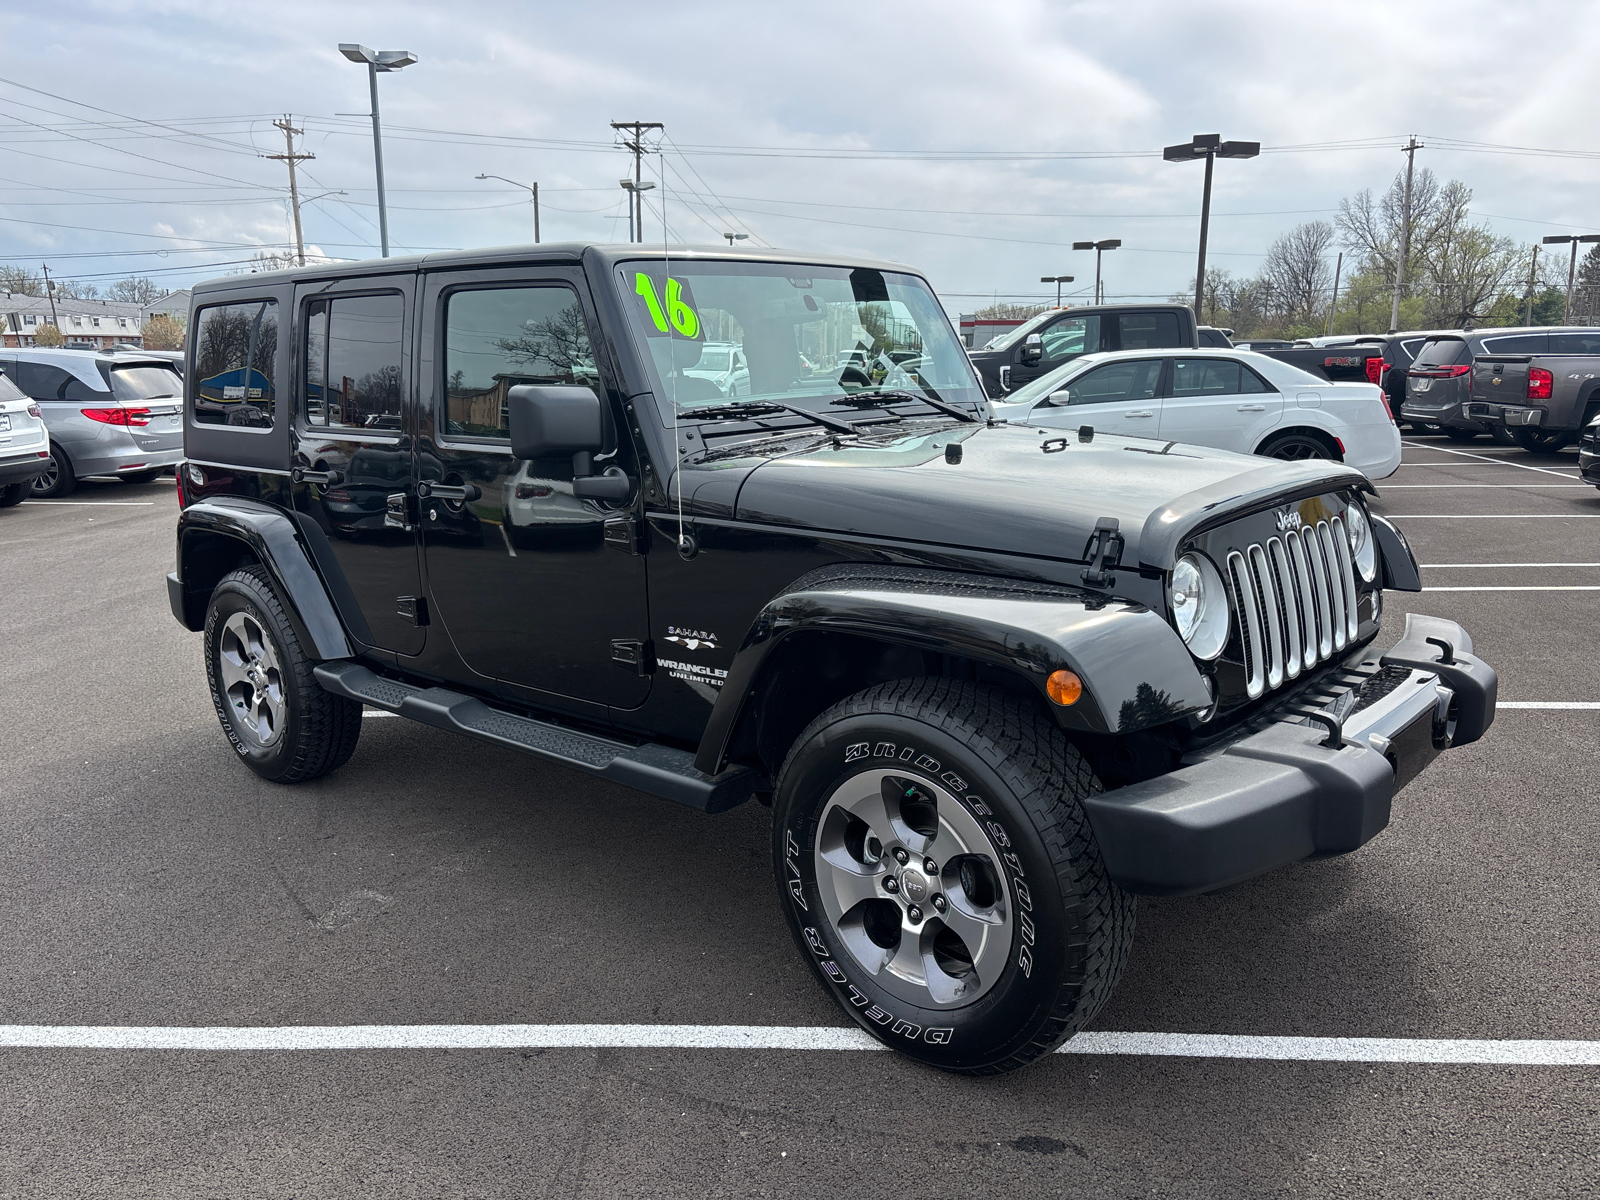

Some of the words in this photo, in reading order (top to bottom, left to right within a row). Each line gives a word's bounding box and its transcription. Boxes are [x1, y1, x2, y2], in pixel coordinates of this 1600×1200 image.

[635, 272, 700, 339] 16
[1325, 356, 1361, 367] FX4
[1277, 511, 1302, 531] Jeep
[668, 626, 718, 641] SAHARA
[669, 671, 725, 686] UNLIMITED
[786, 830, 809, 912] A/T
[844, 741, 1036, 978] BRIDGESTONE
[804, 926, 955, 1046] DUELER
